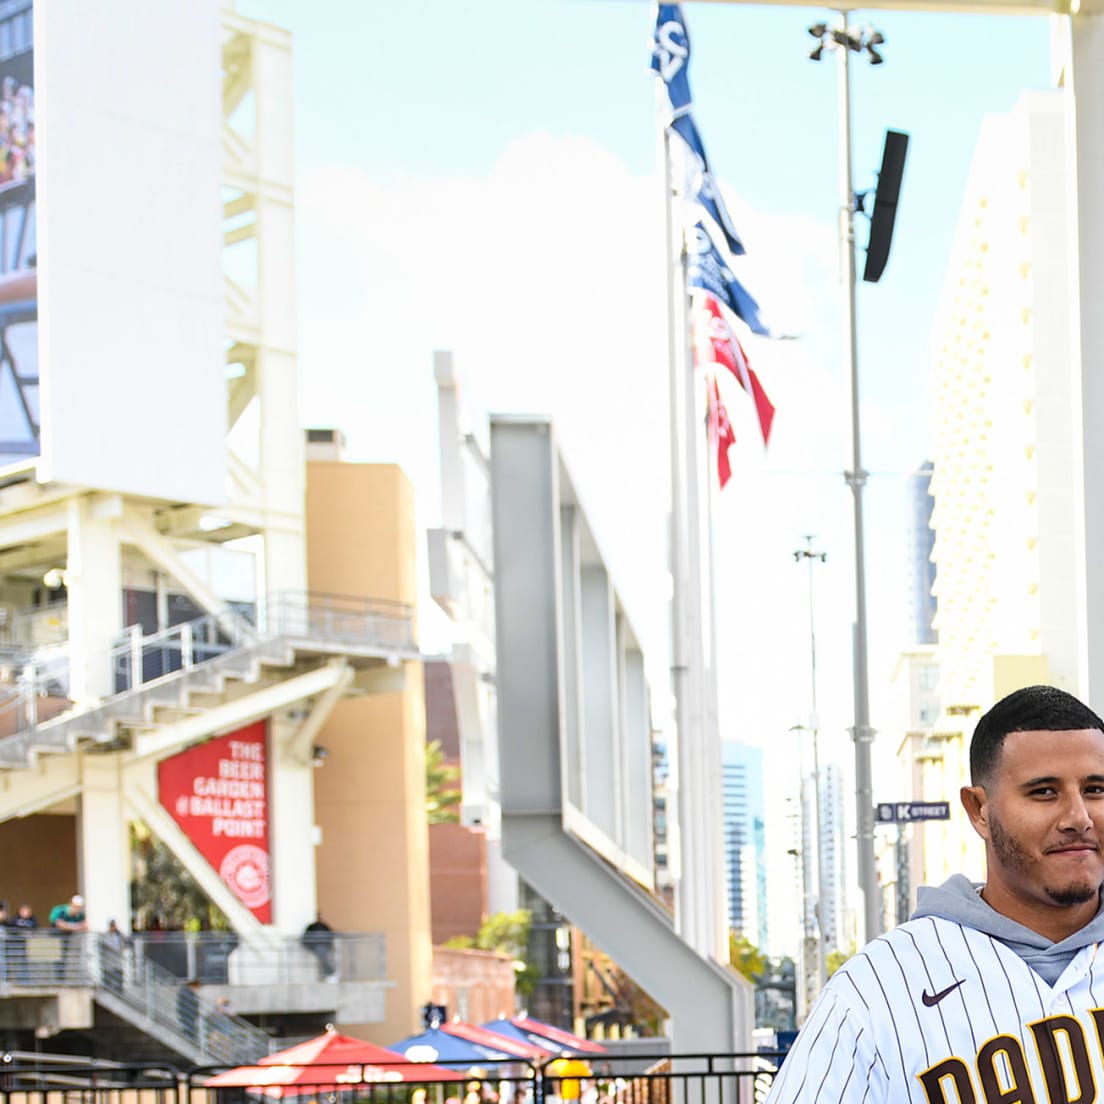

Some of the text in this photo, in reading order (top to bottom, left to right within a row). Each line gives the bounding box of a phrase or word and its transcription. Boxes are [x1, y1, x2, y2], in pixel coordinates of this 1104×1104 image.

[229, 741, 264, 761] THE
[218, 759, 264, 779] BEER
[193, 777, 265, 799] GARDEN
[897, 805, 911, 819] K
[212, 818, 265, 838] POINT
